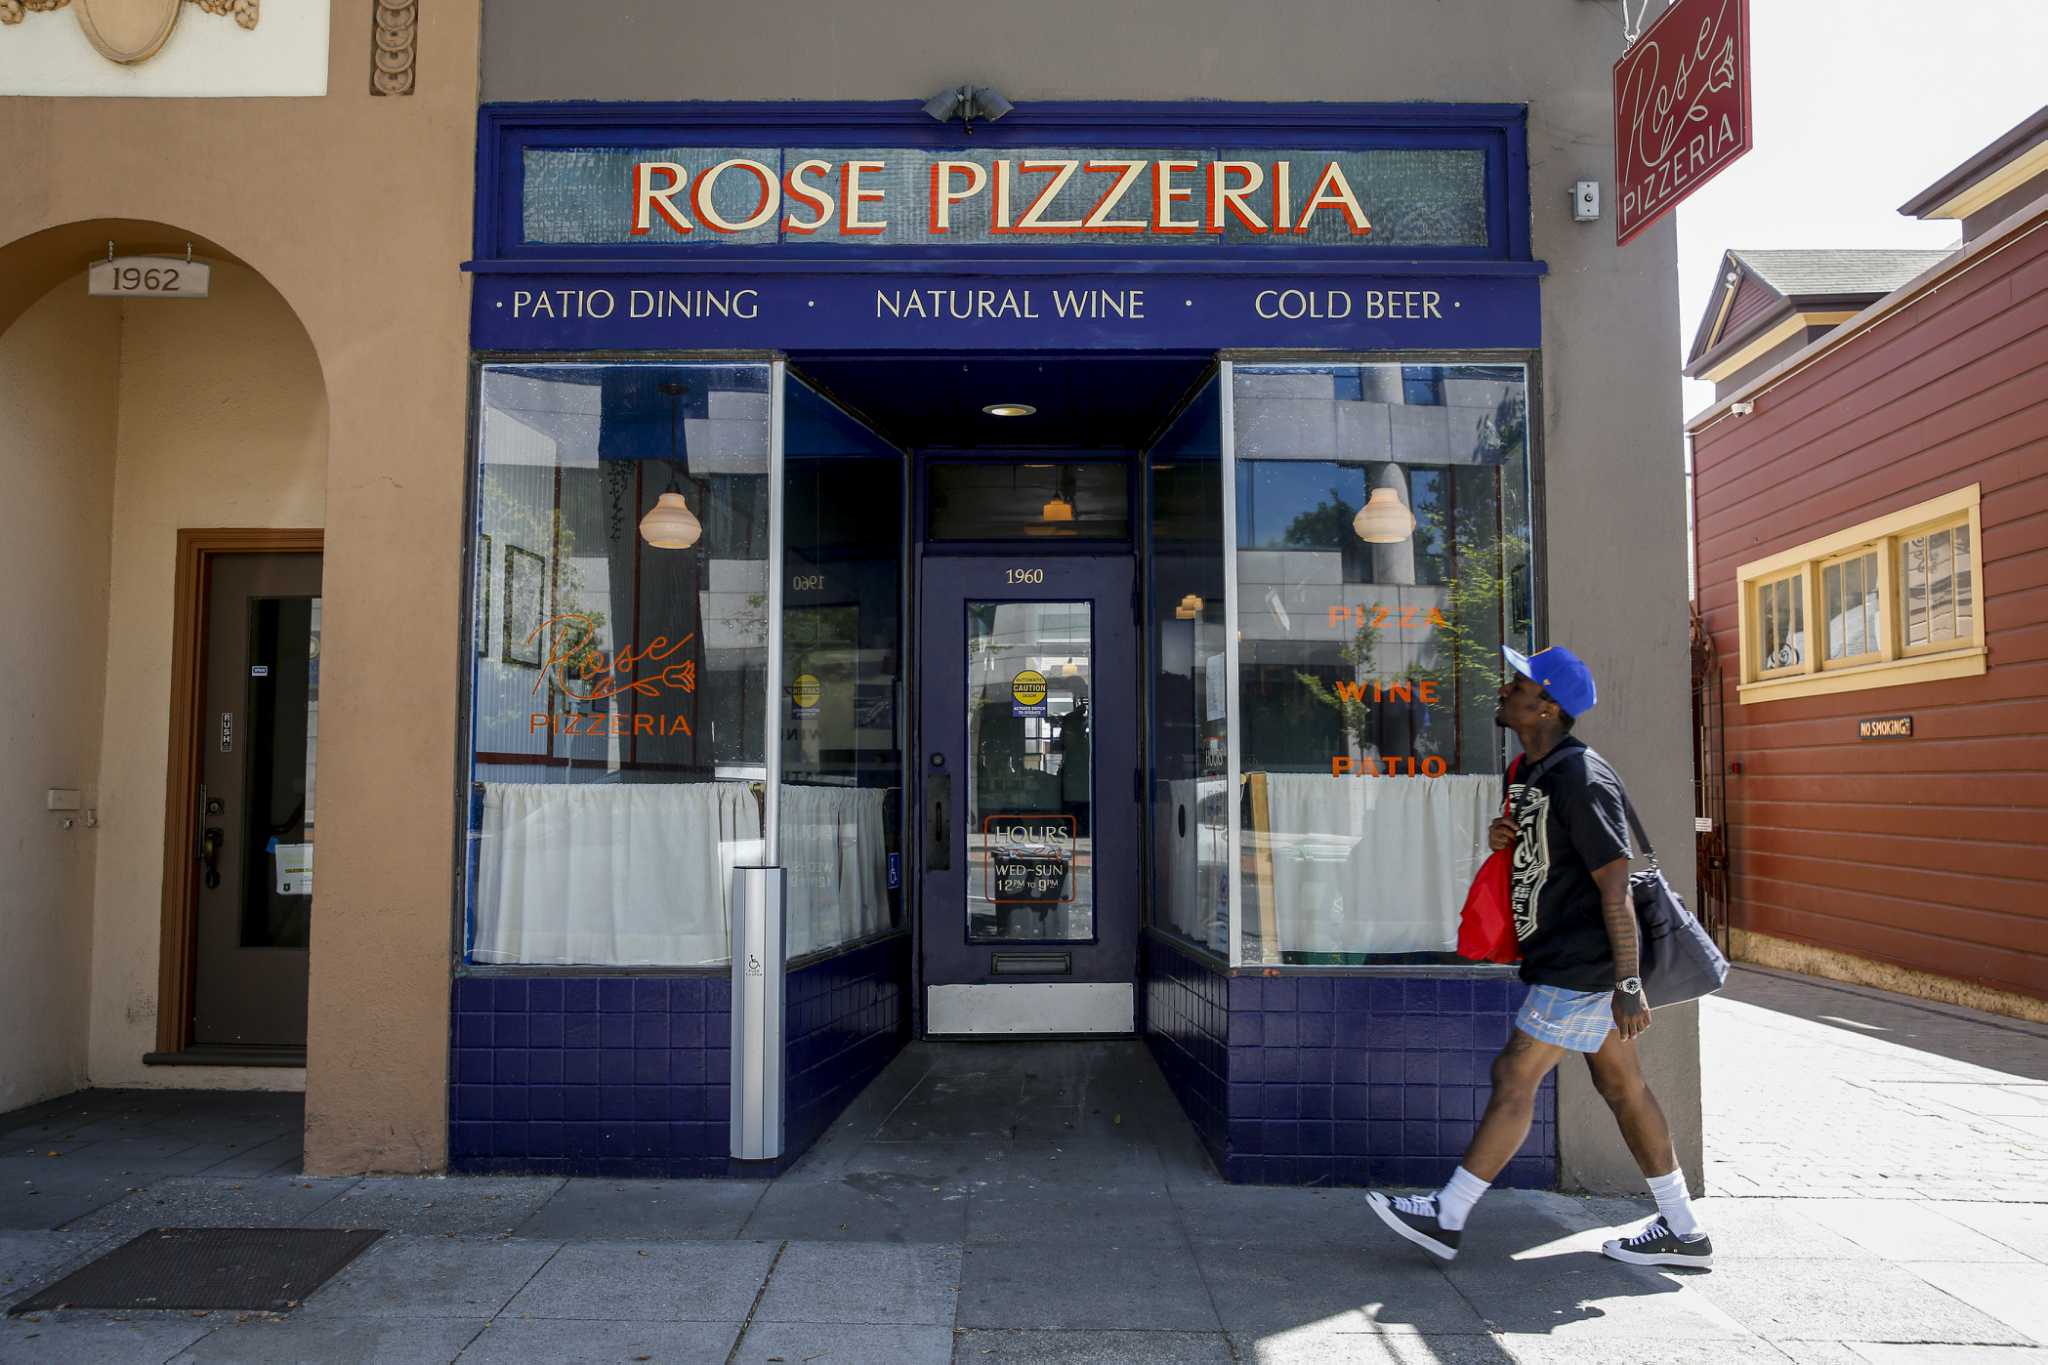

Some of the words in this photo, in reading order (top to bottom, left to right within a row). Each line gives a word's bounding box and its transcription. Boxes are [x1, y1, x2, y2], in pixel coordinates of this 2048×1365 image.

[1620, 0, 1727, 187] Rose
[1623, 113, 1734, 225] PIZZERIA
[631, 159, 888, 235] ROSE
[929, 159, 1373, 235] PIZZERIA
[112, 267, 180, 291] 1962
[513, 289, 615, 319] PATIO
[629, 289, 758, 319] DINING
[876, 289, 1039, 319] NATURAL
[1053, 289, 1145, 319] WINE
[1255, 289, 1352, 319] COLD
[1366, 289, 1443, 319] BEER
[1006, 568, 1043, 584] 1960
[1328, 605, 1445, 629] PIZZA
[527, 613, 695, 699] Rose
[1013, 684, 1046, 692] CAUTION
[1335, 680, 1441, 704] WINE
[529, 713, 692, 737] PIZZERIA
[1860, 722, 1871, 736] NO
[1331, 755, 1448, 778] PATIO
[994, 826, 1069, 844] HOURS
[1038, 879, 1058, 892] 9PM
